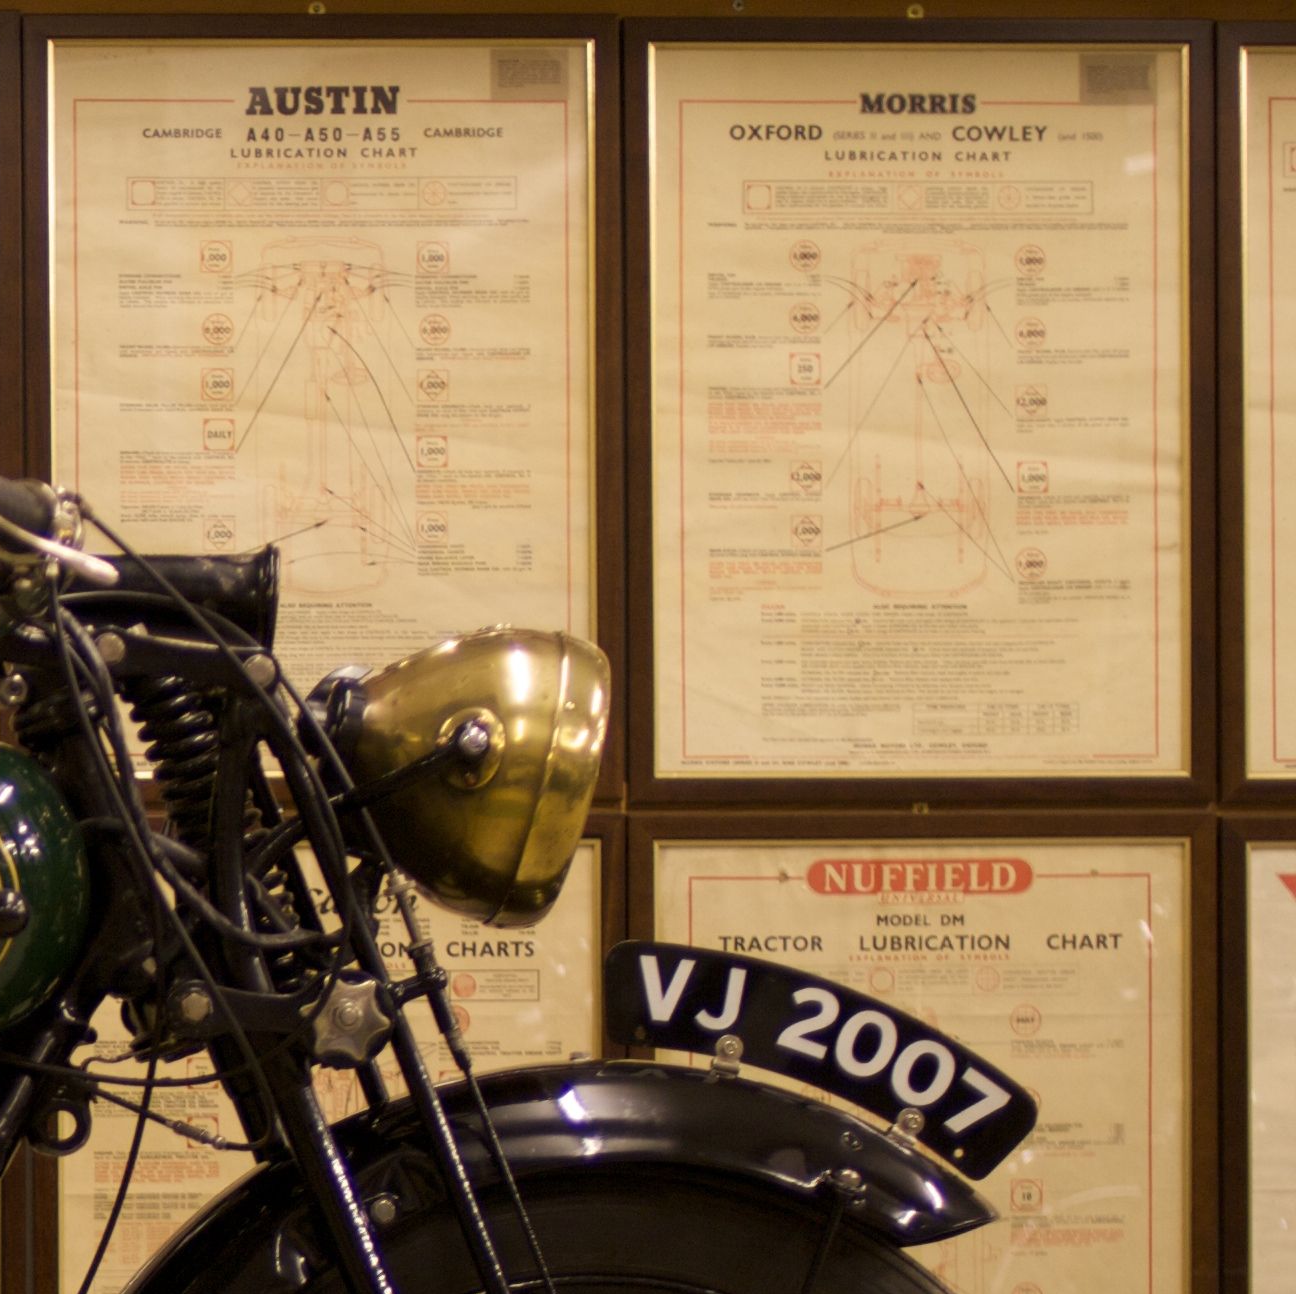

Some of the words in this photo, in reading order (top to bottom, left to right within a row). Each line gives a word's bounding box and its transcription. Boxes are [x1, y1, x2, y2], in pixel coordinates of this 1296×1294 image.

[245, 86, 400, 115] AUSTIN
[859, 93, 977, 114] MORRIS
[143, 128, 223, 139] CAMBRIDGE
[424, 127, 504, 138] CAMBRIDGE
[729, 124, 823, 142] OXFORD
[952, 125, 1047, 142] COWLEY
[230, 147, 348, 159] LUBRICATION
[361, 146, 419, 158] CHART
[824, 150, 943, 162] LUBRICATION
[954, 150, 1013, 162] CHART
[824, 863, 1017, 892] NUFFIELD
[876, 914, 931, 927] MODEL
[940, 914, 965, 926] DM
[446, 941, 536, 958] CHARTS
[719, 936, 823, 952] TRACTOR
[859, 934, 1012, 952] LUBRICATION
[1046, 933, 1124, 951] CHART
[639, 954, 748, 1032] VJ
[776, 987, 1013, 1136] 2007
